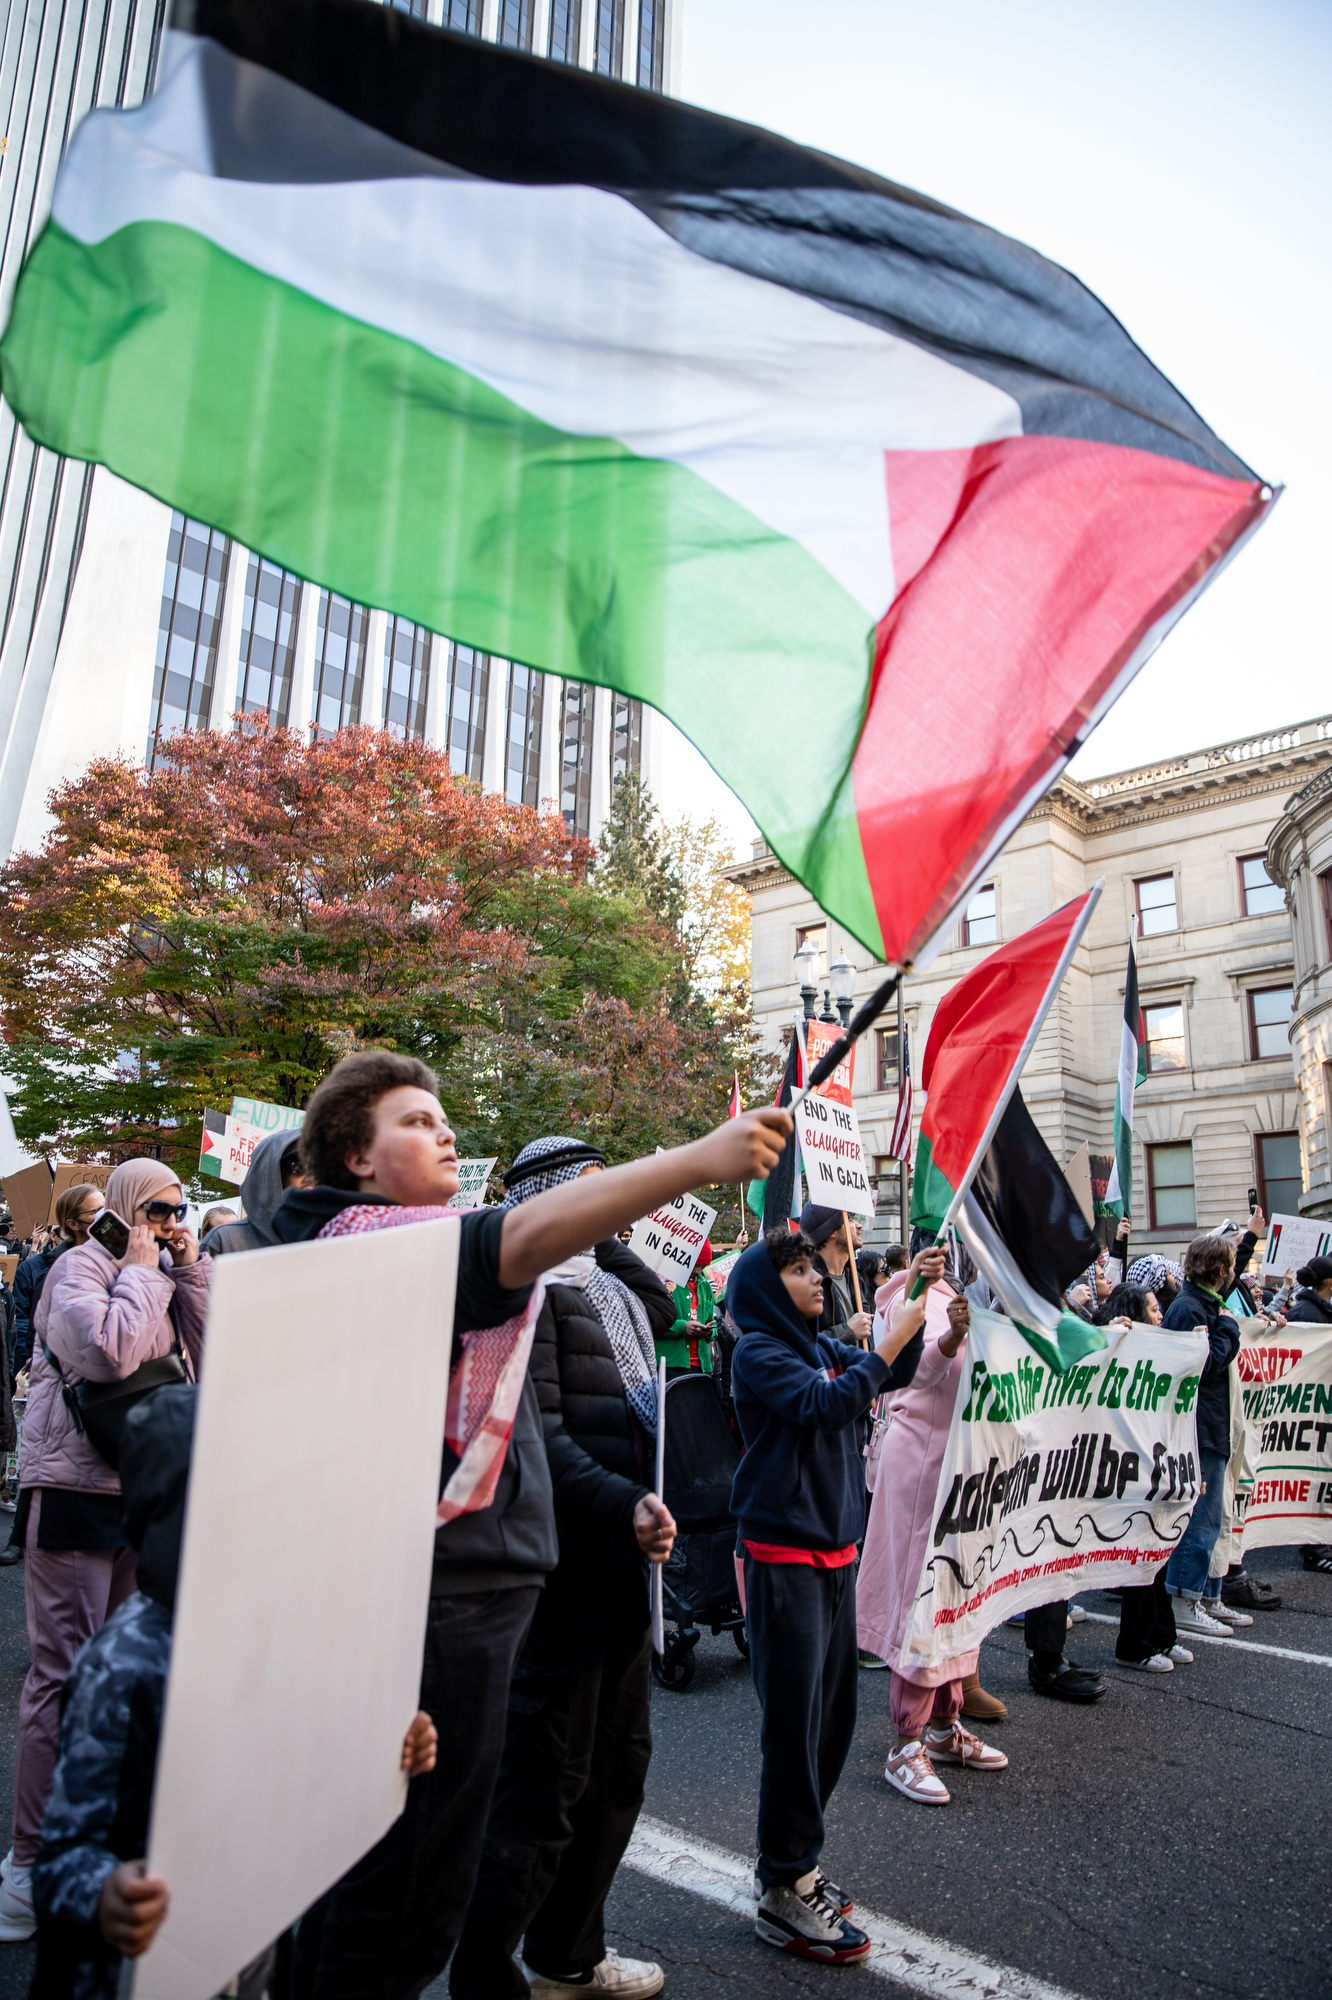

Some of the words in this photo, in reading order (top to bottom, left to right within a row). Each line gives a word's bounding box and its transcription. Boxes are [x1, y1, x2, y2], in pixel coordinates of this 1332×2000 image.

[233, 1097, 281, 1131] END
[803, 1098, 828, 1122] END
[832, 1107, 853, 1132] THE
[805, 1128, 861, 1162] SLAUGHTER
[458, 1164, 475, 1178] END
[474, 1163, 489, 1178] THE
[818, 1161, 835, 1183] IN
[836, 1166, 868, 1192] GAZA
[670, 1194, 685, 1210] ND
[687, 1202, 708, 1226] THE
[647, 1208, 704, 1248] SLAUGHTER
[645, 1231, 662, 1251] IN
[661, 1241, 693, 1270] GAZA
[1017, 1355, 1044, 1417] the
[1042, 1363, 1100, 1413] river,
[1097, 1357, 1129, 1409] to
[1125, 1359, 1172, 1413] the
[1260, 1420, 1332, 1454] SANCT
[1038, 1433, 1098, 1502] will
[1092, 1433, 1140, 1499] be
[1248, 1479, 1312, 1507] LESTINE
